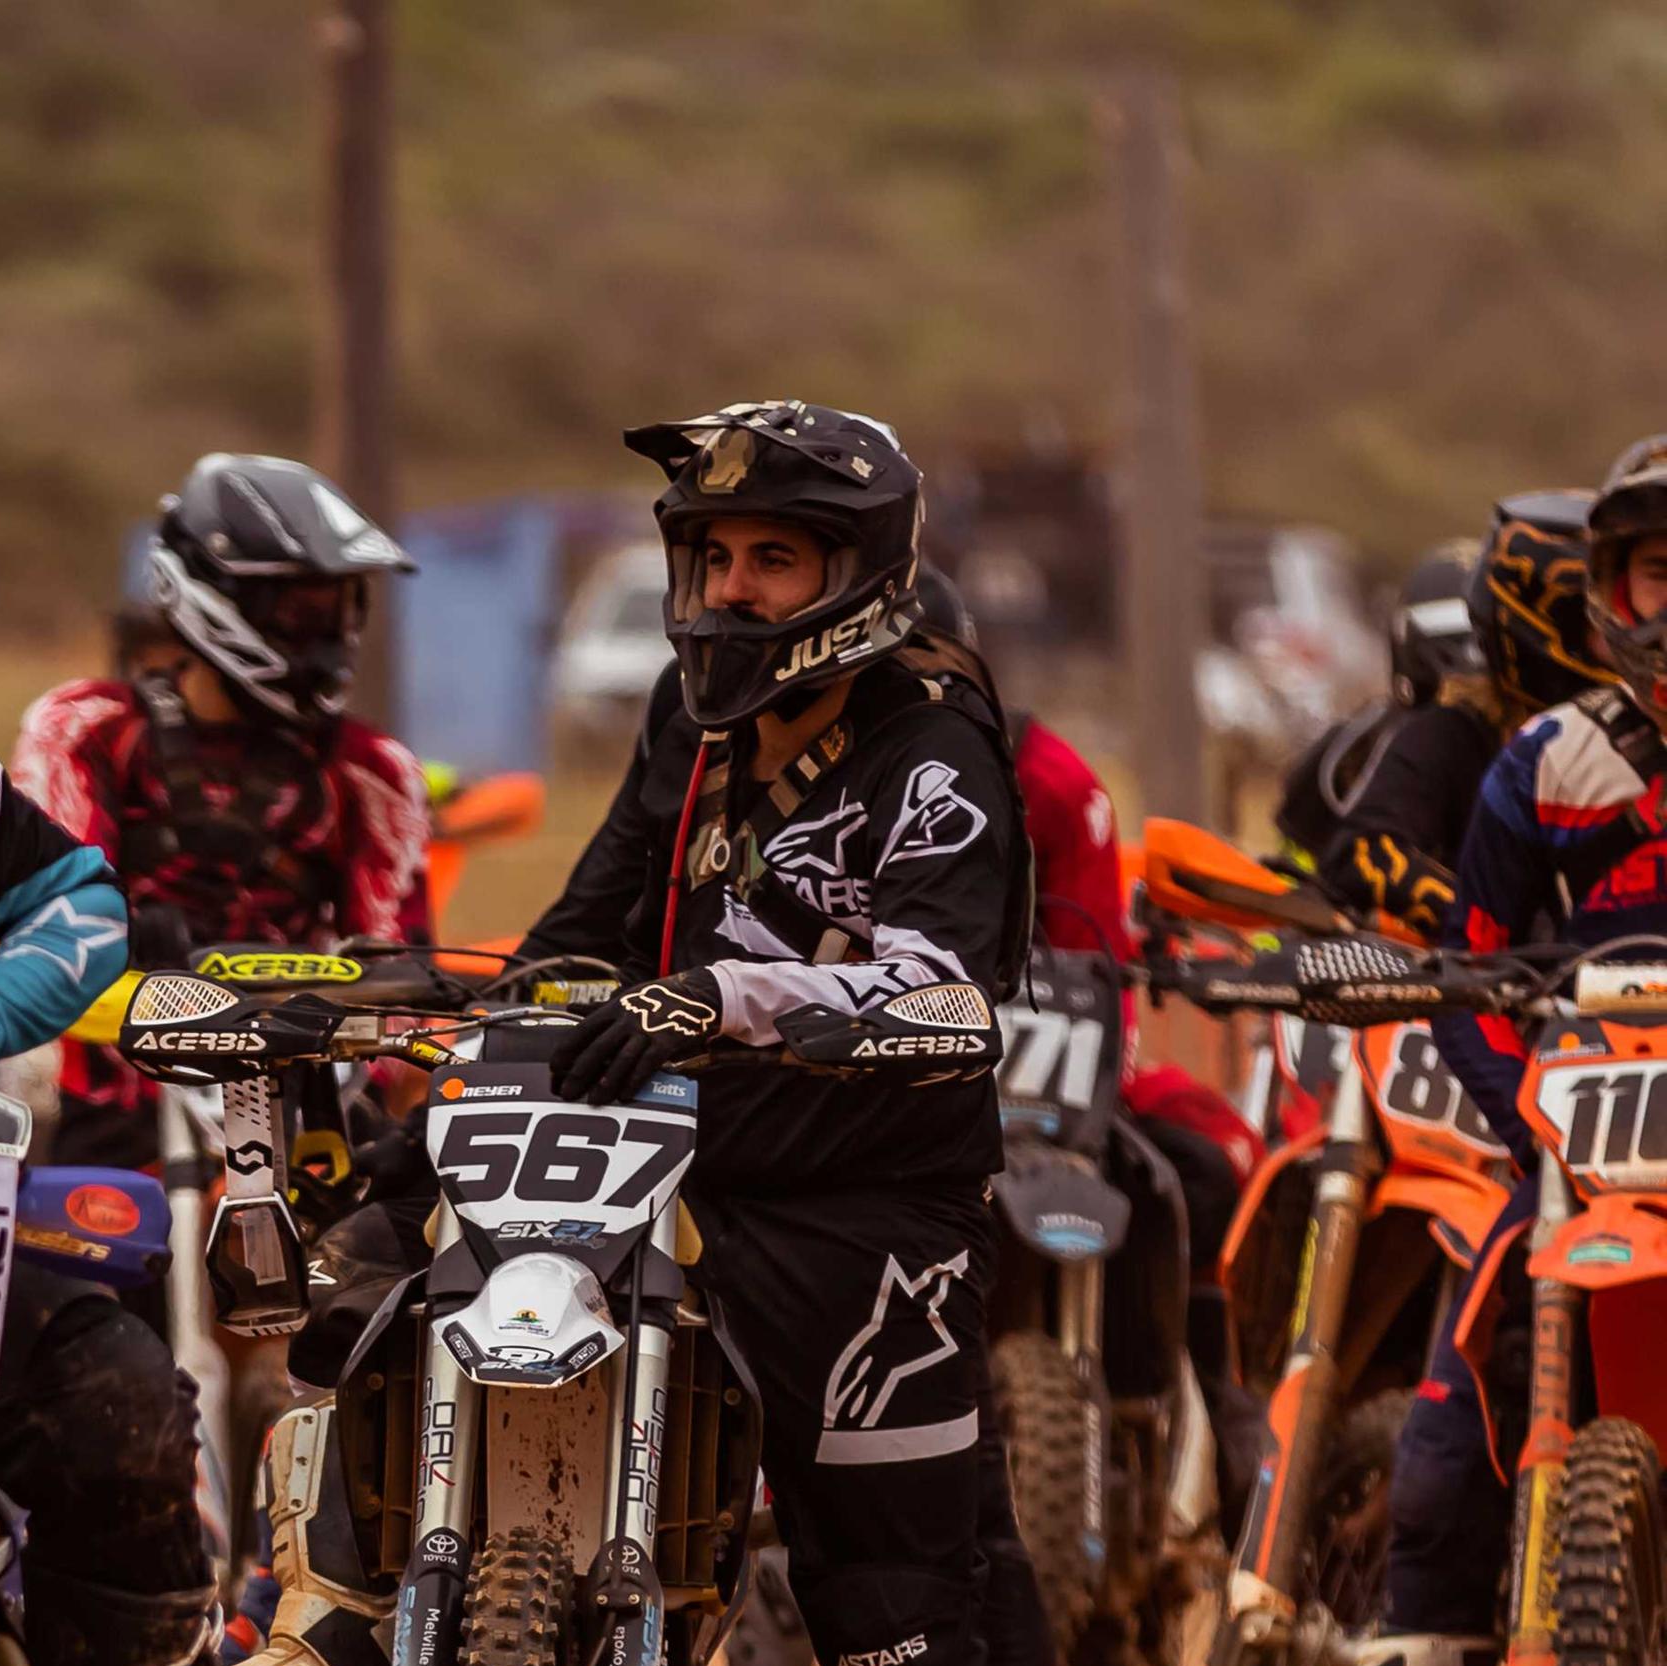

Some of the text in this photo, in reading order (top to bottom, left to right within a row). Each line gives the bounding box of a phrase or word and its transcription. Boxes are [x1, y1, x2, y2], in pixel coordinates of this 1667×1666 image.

[132, 1031, 267, 1051] ACERBIS
[851, 1035, 988, 1057] ACERBIS
[651, 1080, 686, 1098] Tatts
[437, 1112, 697, 1209] 567
[423, 1554, 458, 1566] TOYOTA
[605, 1565, 641, 1577] TOTA
[420, 1608, 441, 1666] Melville
